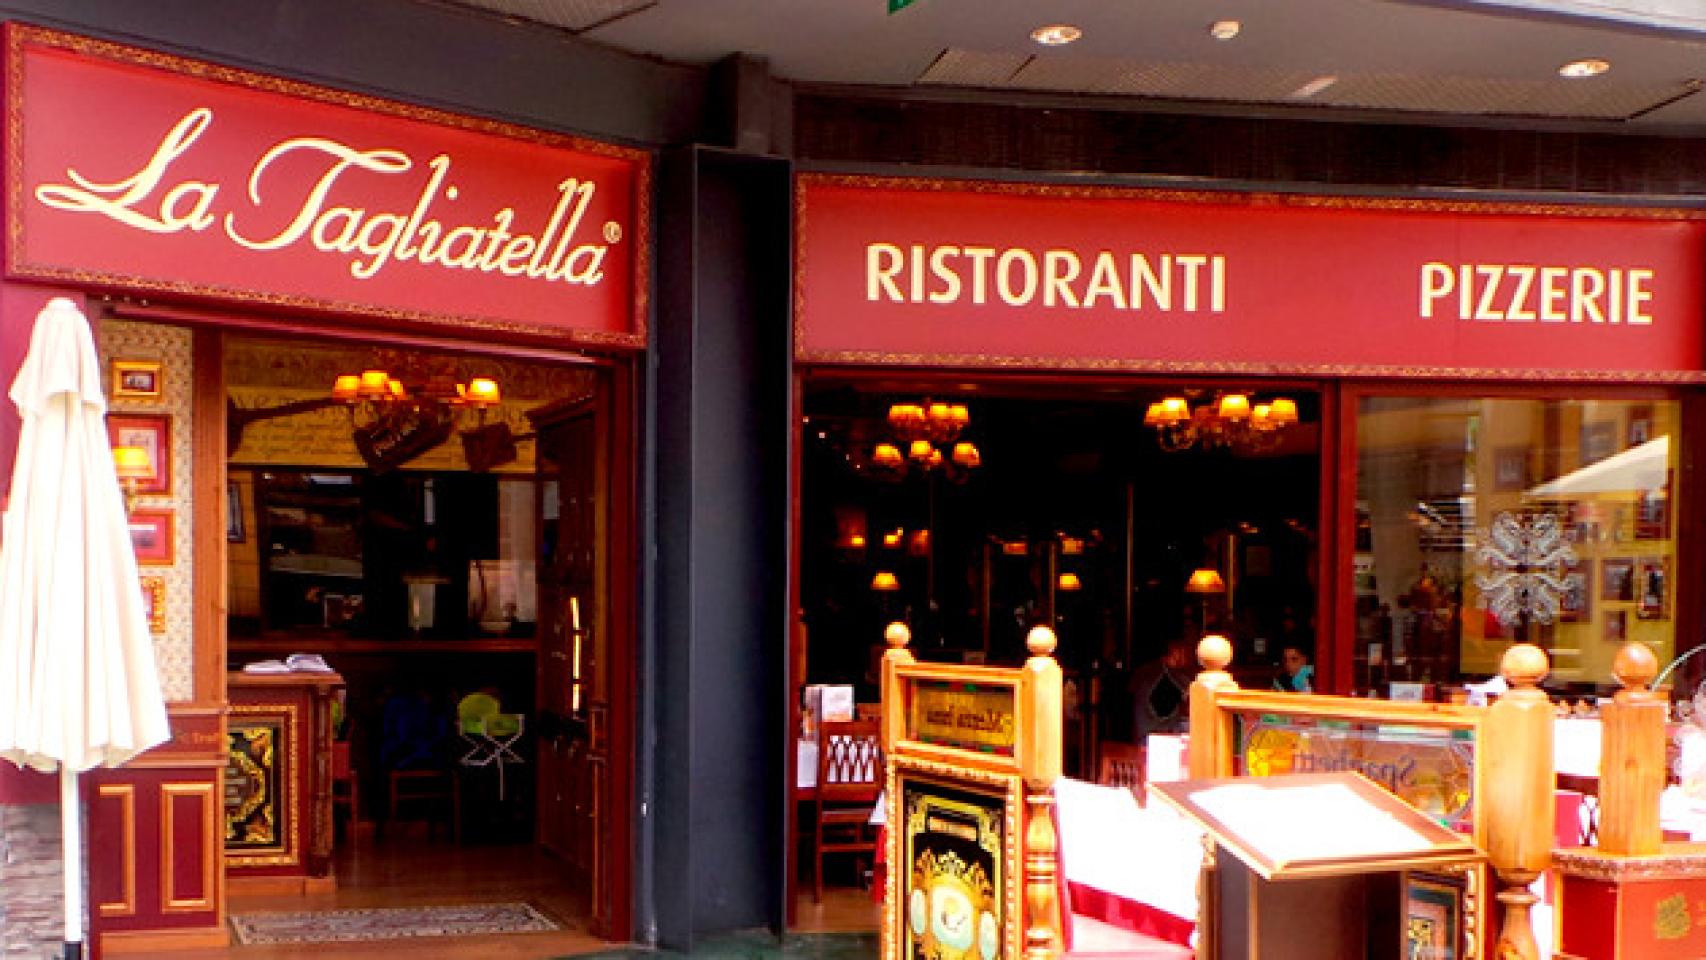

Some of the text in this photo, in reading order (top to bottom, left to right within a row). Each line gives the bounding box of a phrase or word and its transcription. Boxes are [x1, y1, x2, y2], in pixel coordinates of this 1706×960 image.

[35, 107, 607, 285] La Tagliatella
[867, 243, 1226, 312] RISTORANTI
[1420, 262, 1654, 325] PIZZERIE
